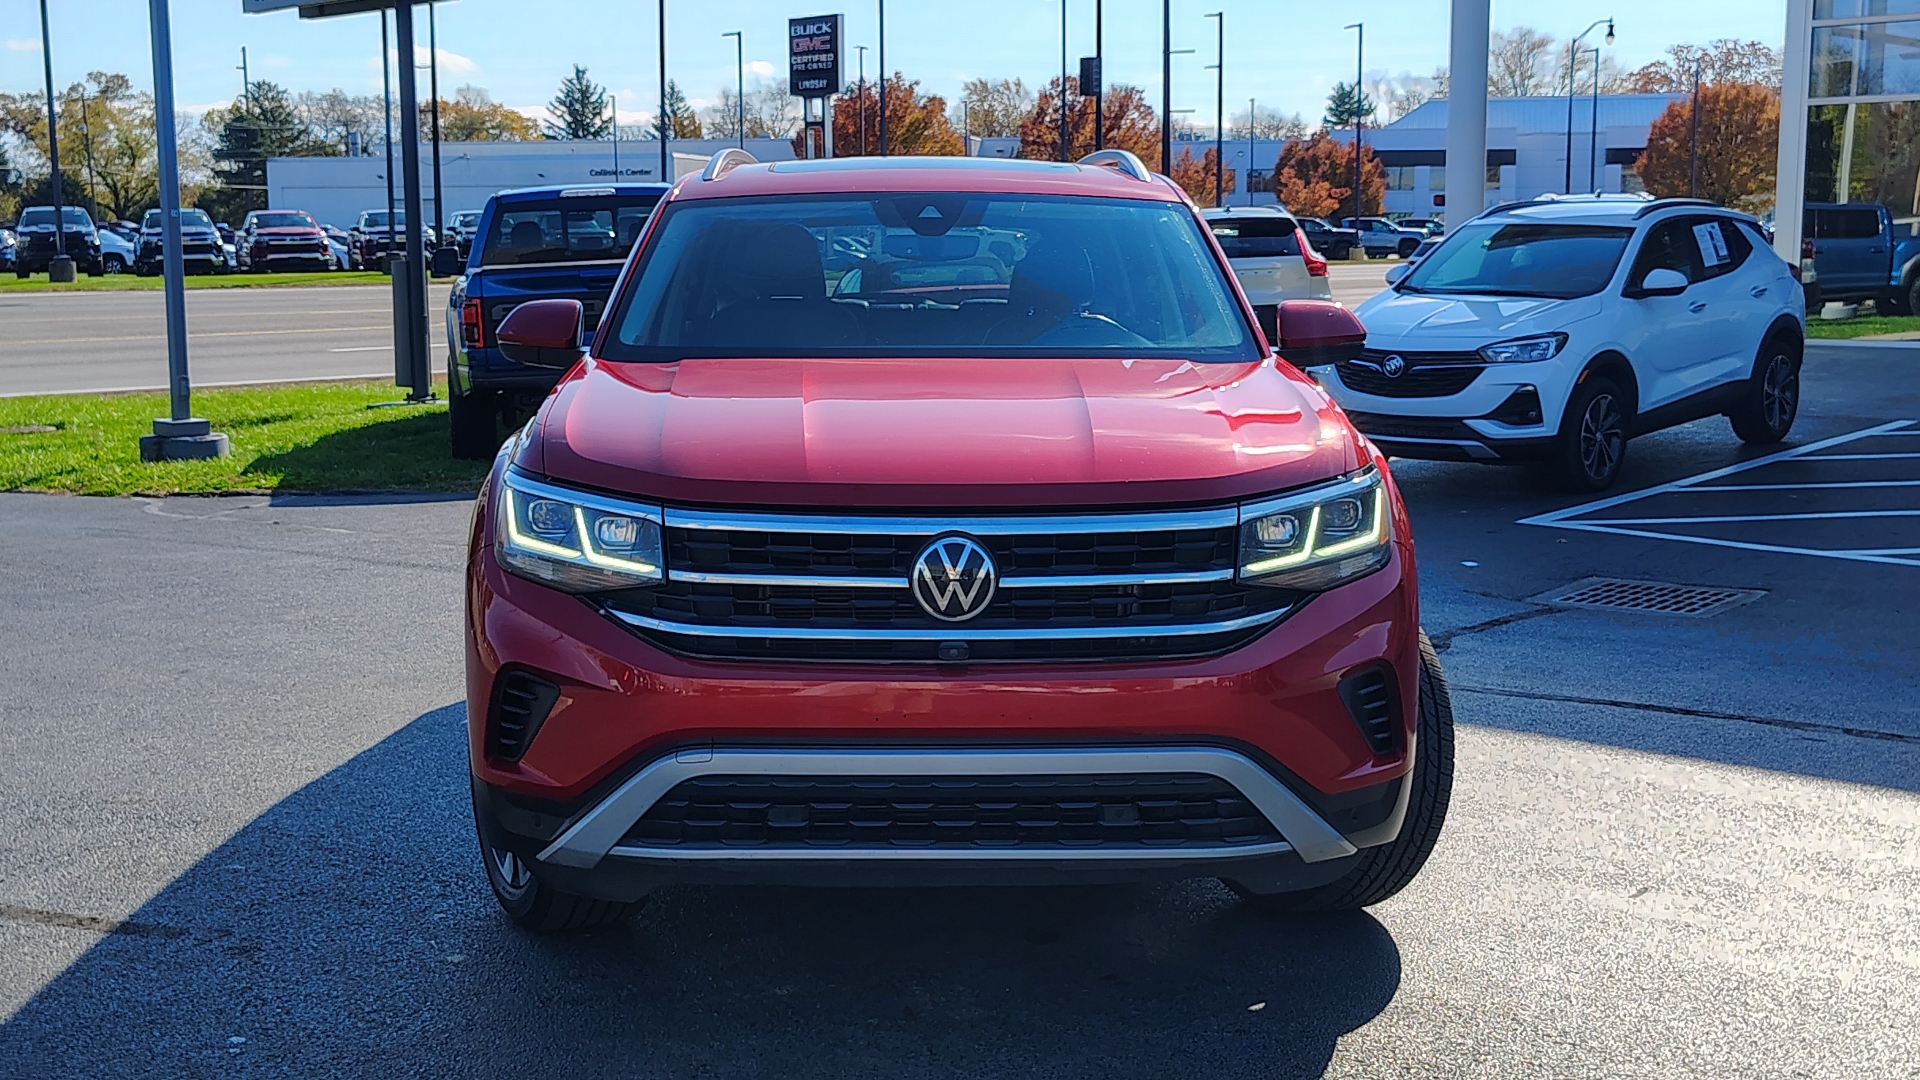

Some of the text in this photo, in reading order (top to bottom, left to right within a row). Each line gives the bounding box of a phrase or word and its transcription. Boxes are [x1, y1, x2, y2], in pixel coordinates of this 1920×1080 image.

[791, 21, 832, 36] BUICK
[793, 36, 830, 52] GMC
[791, 53, 834, 64] CERTIFIED
[798, 79, 827, 90] LINDSAY
[589, 168, 653, 177] Collisin Center
[917, 540, 990, 616] VW
